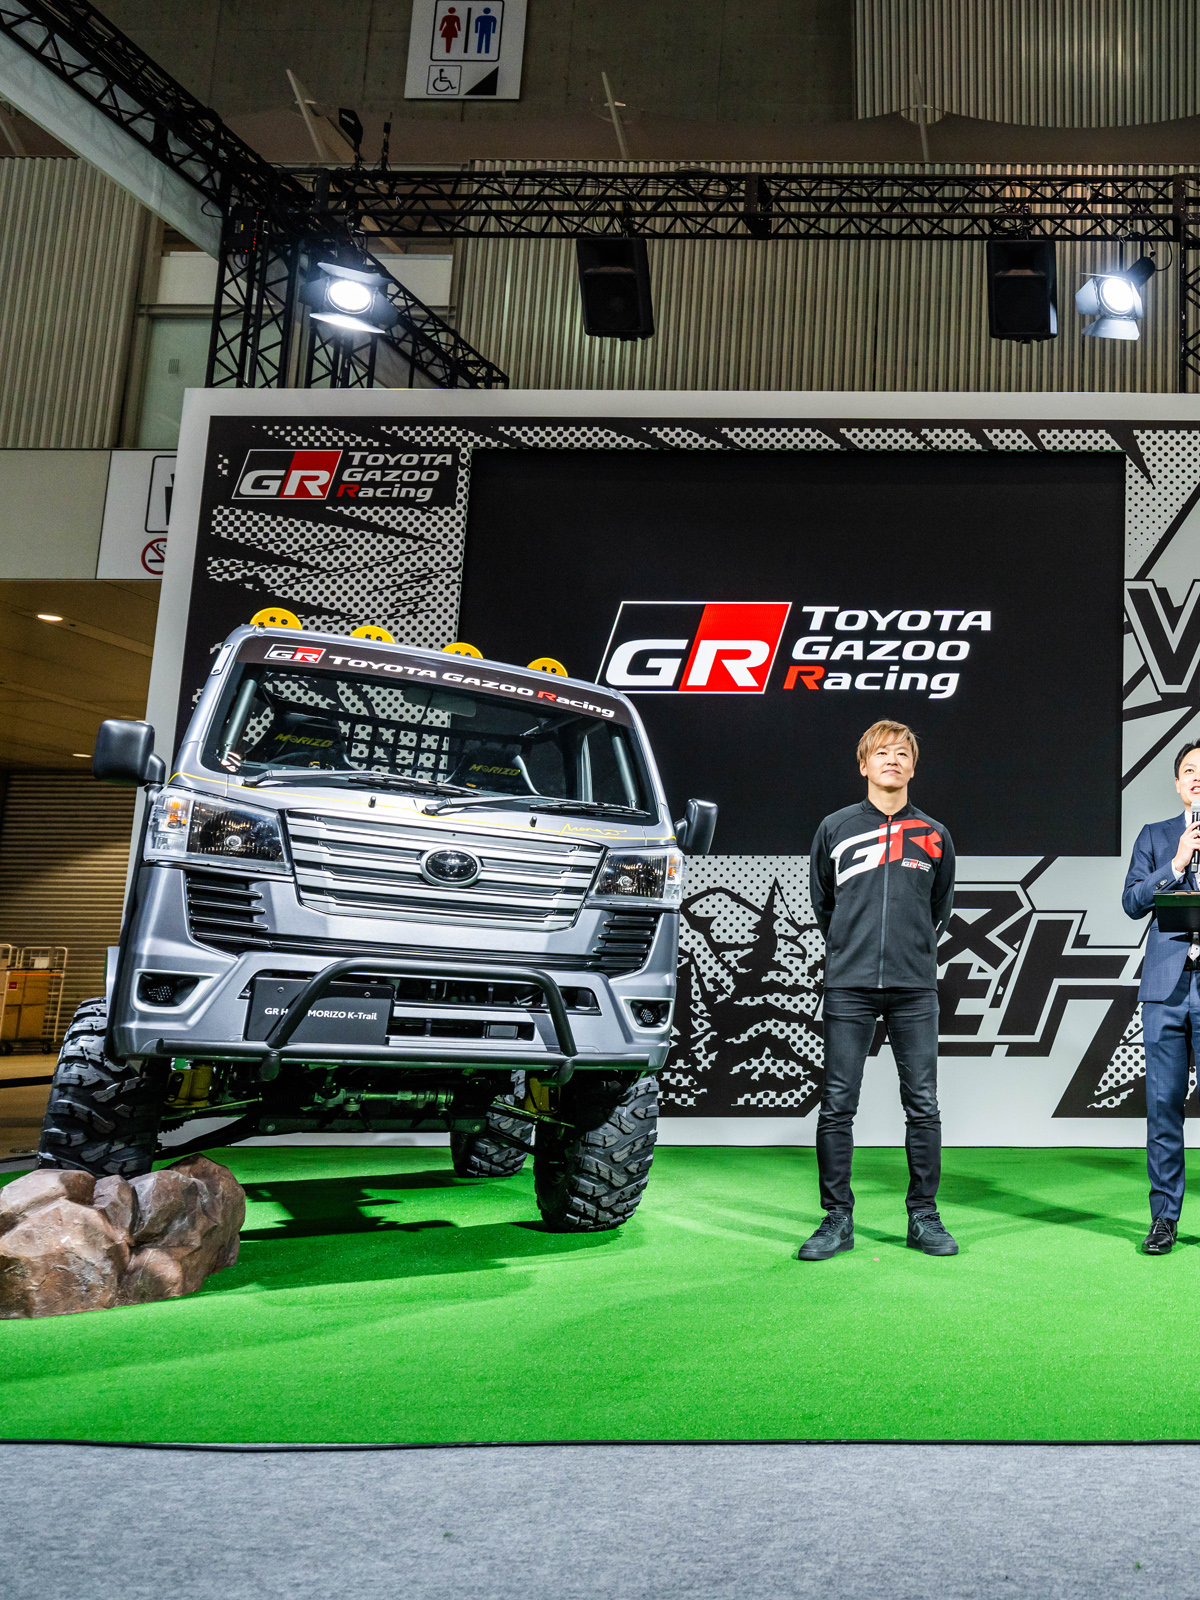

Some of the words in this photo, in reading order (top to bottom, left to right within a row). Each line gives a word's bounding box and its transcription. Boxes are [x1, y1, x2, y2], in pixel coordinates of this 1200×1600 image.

[348, 451, 452, 466] TOYOTA
[239, 469, 331, 496] GR
[341, 467, 440, 482] GAZOO
[336, 483, 433, 502] Racing
[801, 605, 992, 631] TOYOTA
[791, 635, 971, 661] GAZOO
[605, 638, 770, 687] GR
[270, 650, 323, 663] GR
[328, 655, 437, 678] TOYOTA
[442, 672, 534, 697] GAZOO
[537, 690, 615, 718] Racing
[782, 664, 960, 699] Racing
[830, 819, 943, 887] GR
[264, 1007, 279, 1016] GR
[307, 1009, 346, 1019] MORIZO
[347, 1011, 377, 1020] K-Trail
